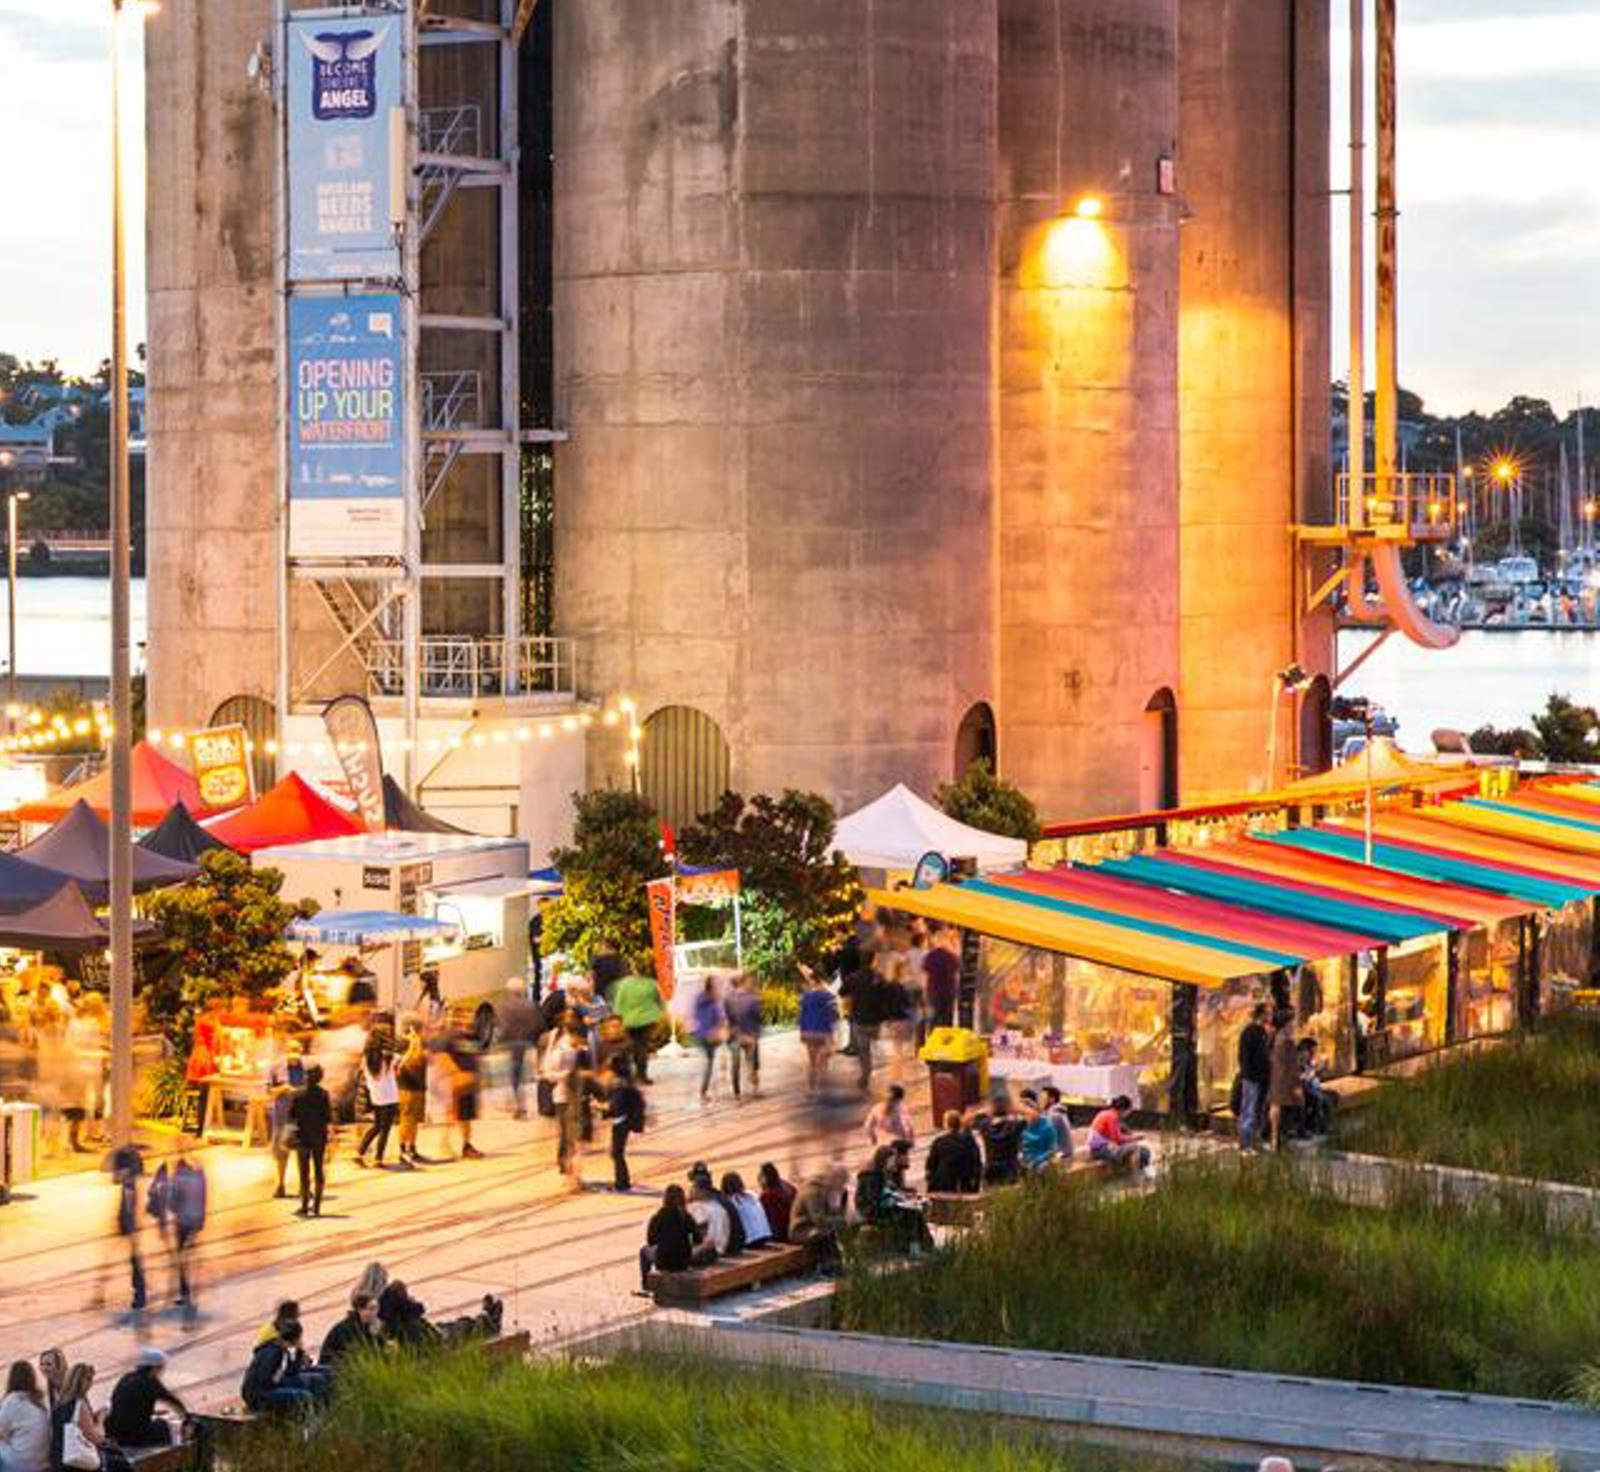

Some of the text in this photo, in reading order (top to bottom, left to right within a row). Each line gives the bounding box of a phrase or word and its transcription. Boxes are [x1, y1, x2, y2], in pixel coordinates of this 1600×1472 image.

[320, 89, 368, 108] ANGEL
[318, 196, 372, 215] NEEDS
[299, 358, 393, 389] OPENING
[299, 389, 393, 420] UP YOUR
